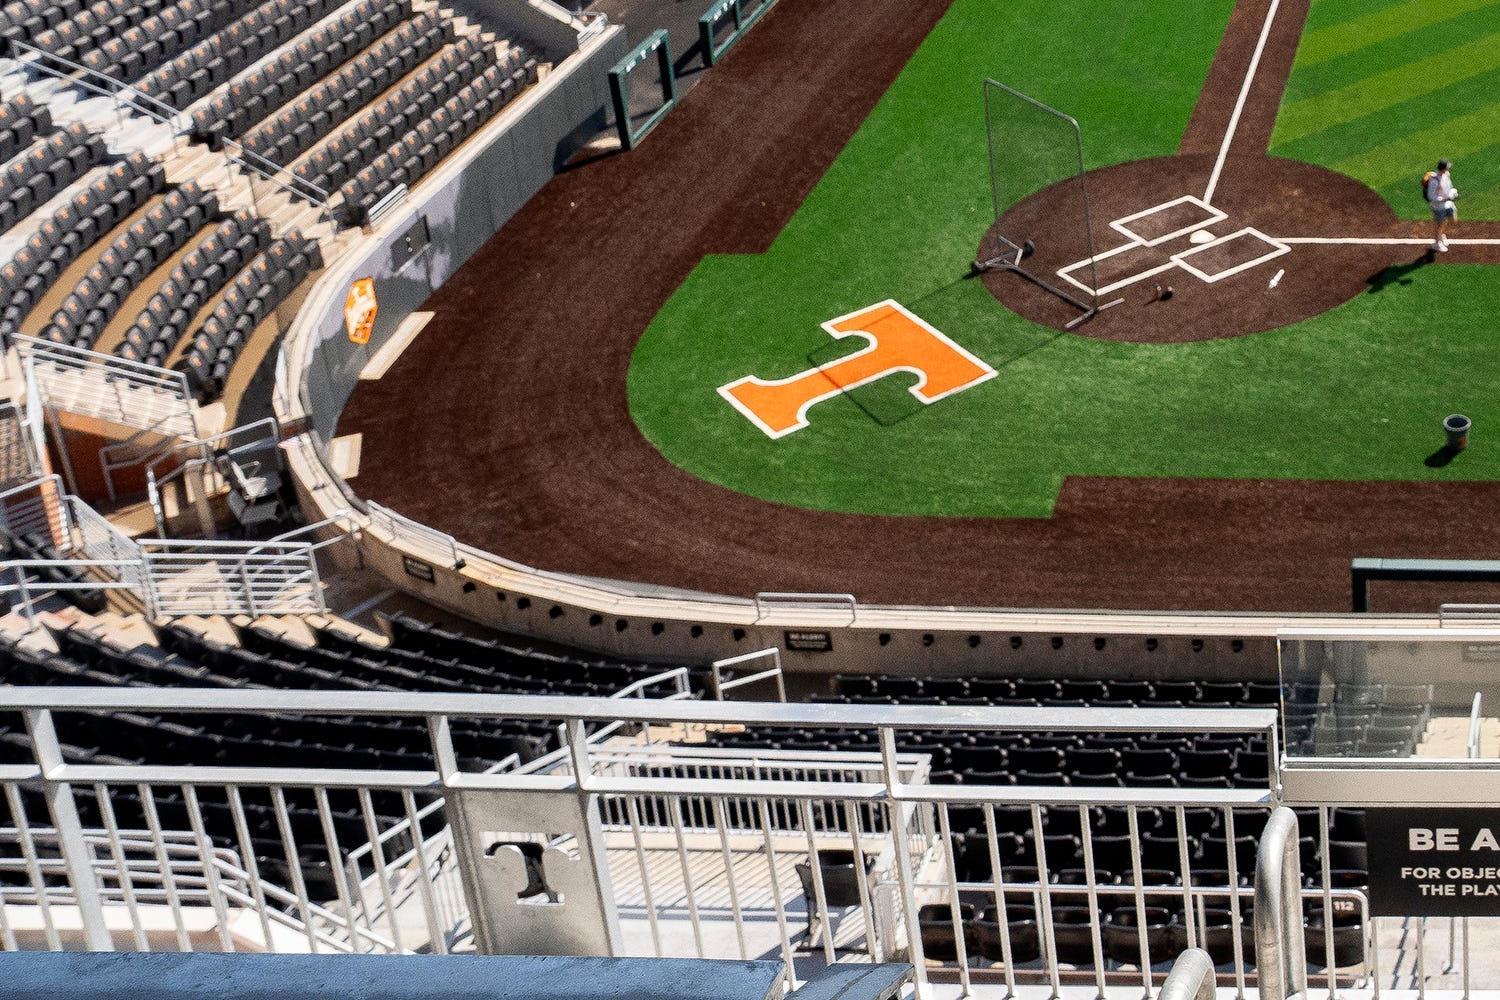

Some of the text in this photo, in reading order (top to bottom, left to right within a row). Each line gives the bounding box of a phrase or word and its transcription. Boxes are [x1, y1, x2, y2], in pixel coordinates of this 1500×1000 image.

[1408, 828, 1460, 851] BE
[1401, 867, 1441, 879] FOR
[1418, 884, 1456, 896] THE
[1333, 901, 1354, 911] 112
